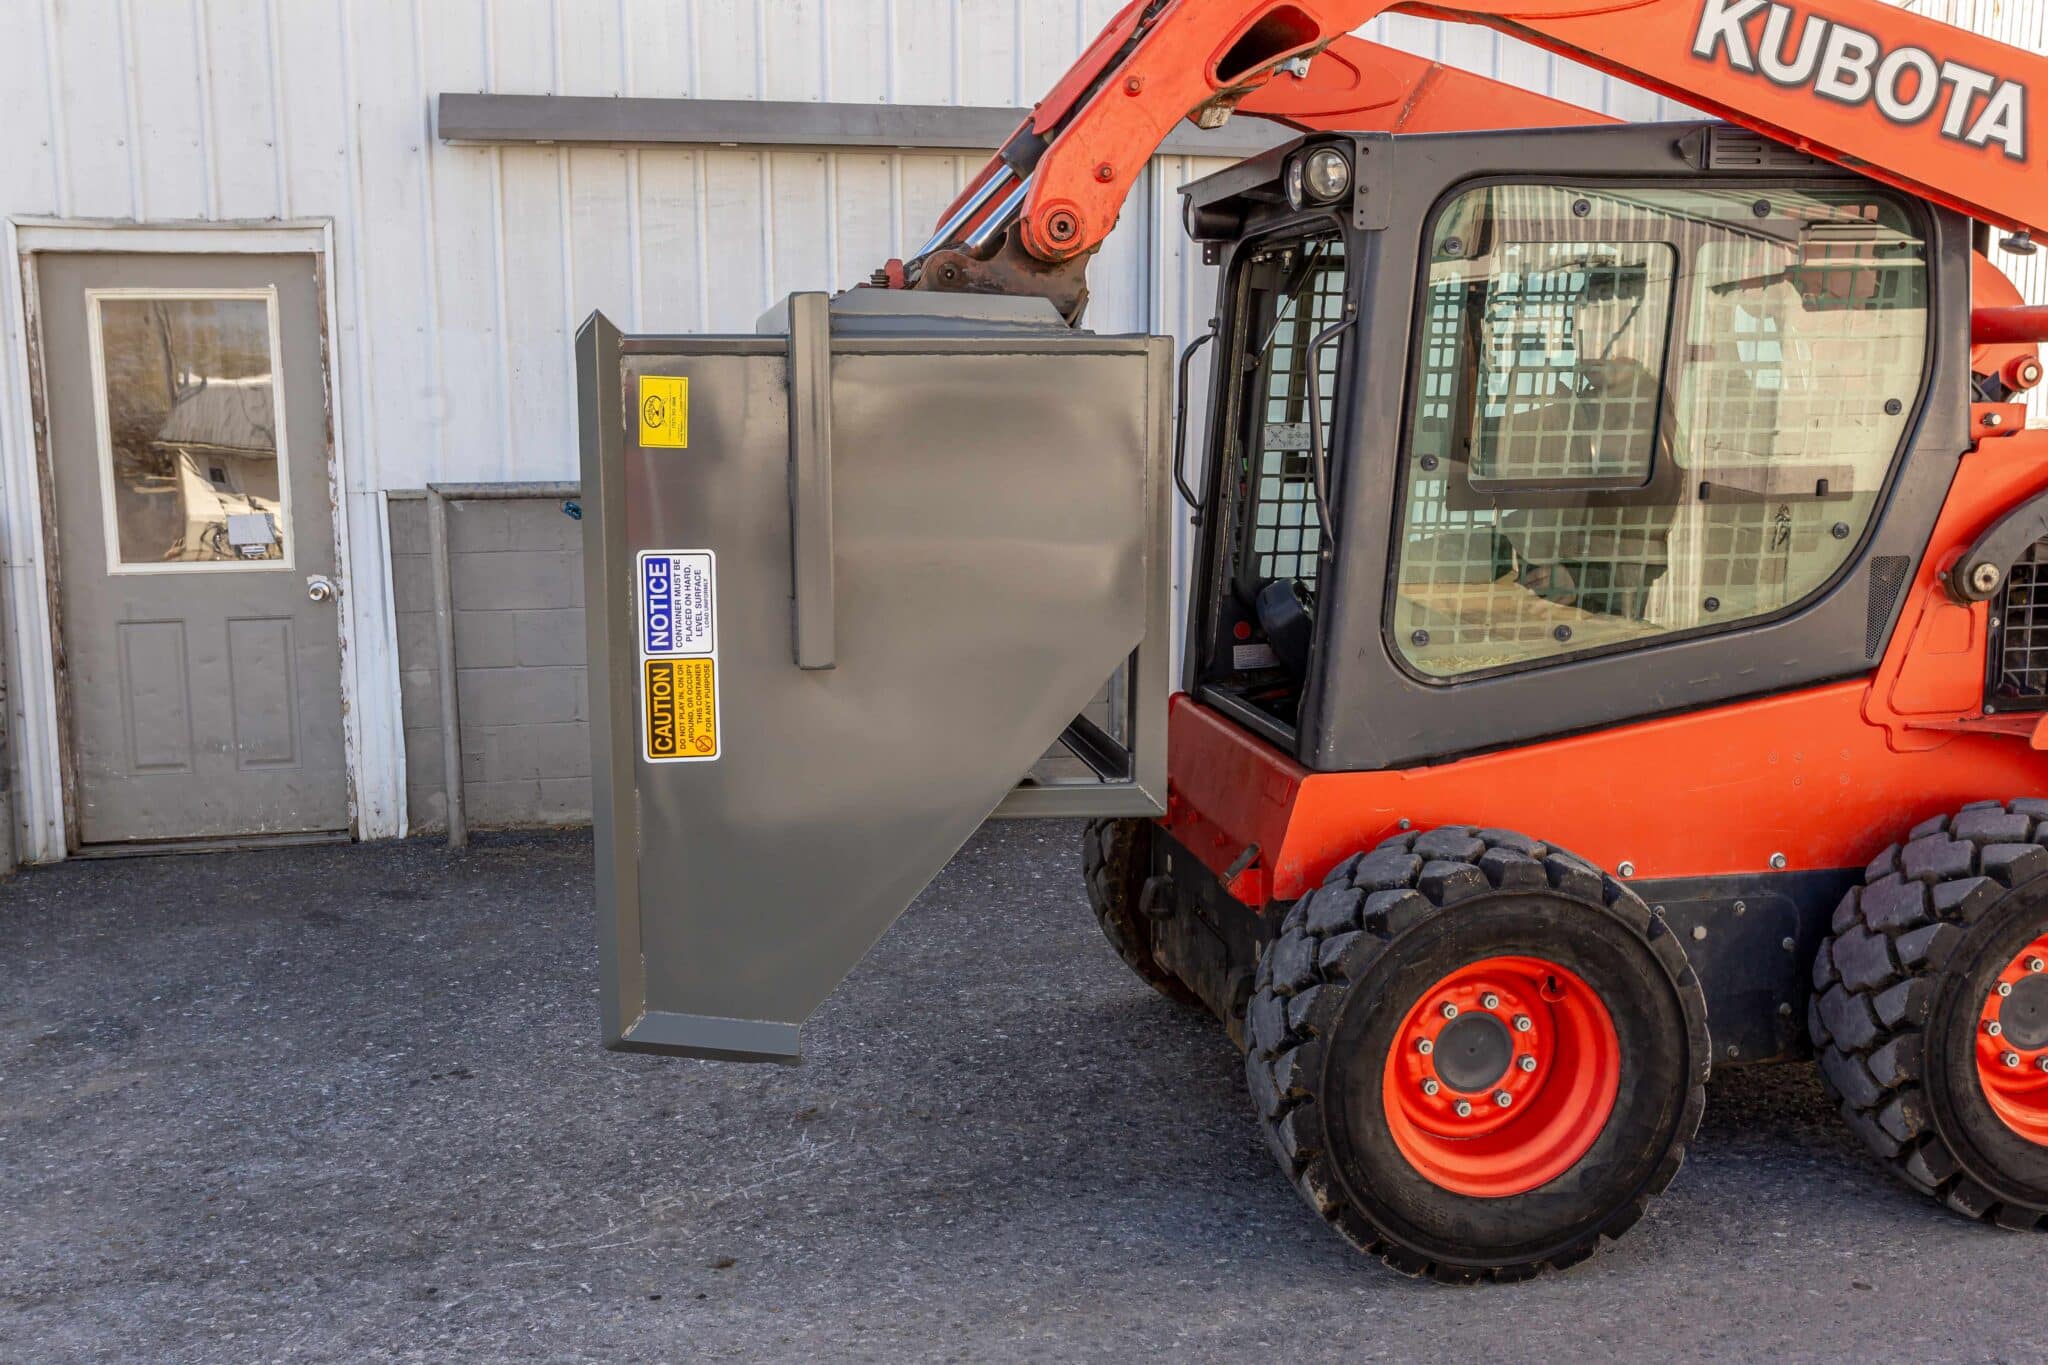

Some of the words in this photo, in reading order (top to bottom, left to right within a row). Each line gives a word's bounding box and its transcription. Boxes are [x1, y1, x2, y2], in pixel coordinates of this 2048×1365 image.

[1691, 0, 2024, 160] KUBOTA
[673, 559, 681, 571] BE
[684, 564, 692, 591] HARD,
[685, 593, 692, 606] ON
[694, 569, 703, 609] SURFACE
[648, 562, 669, 647] NOTICE
[674, 599, 683, 648] CONTAINER
[685, 608, 693, 642] PLACED
[695, 612, 703, 637] LEVEL
[677, 664, 684, 676] OR
[678, 677, 684, 689] ON
[703, 663, 711, 699] PURPOSE
[652, 668, 673, 752] CAUTION
[687, 697, 693, 708] OR
[687, 709, 695, 743] AROUND,
[704, 717, 712, 733] FOR
[679, 739, 686, 750] DO
